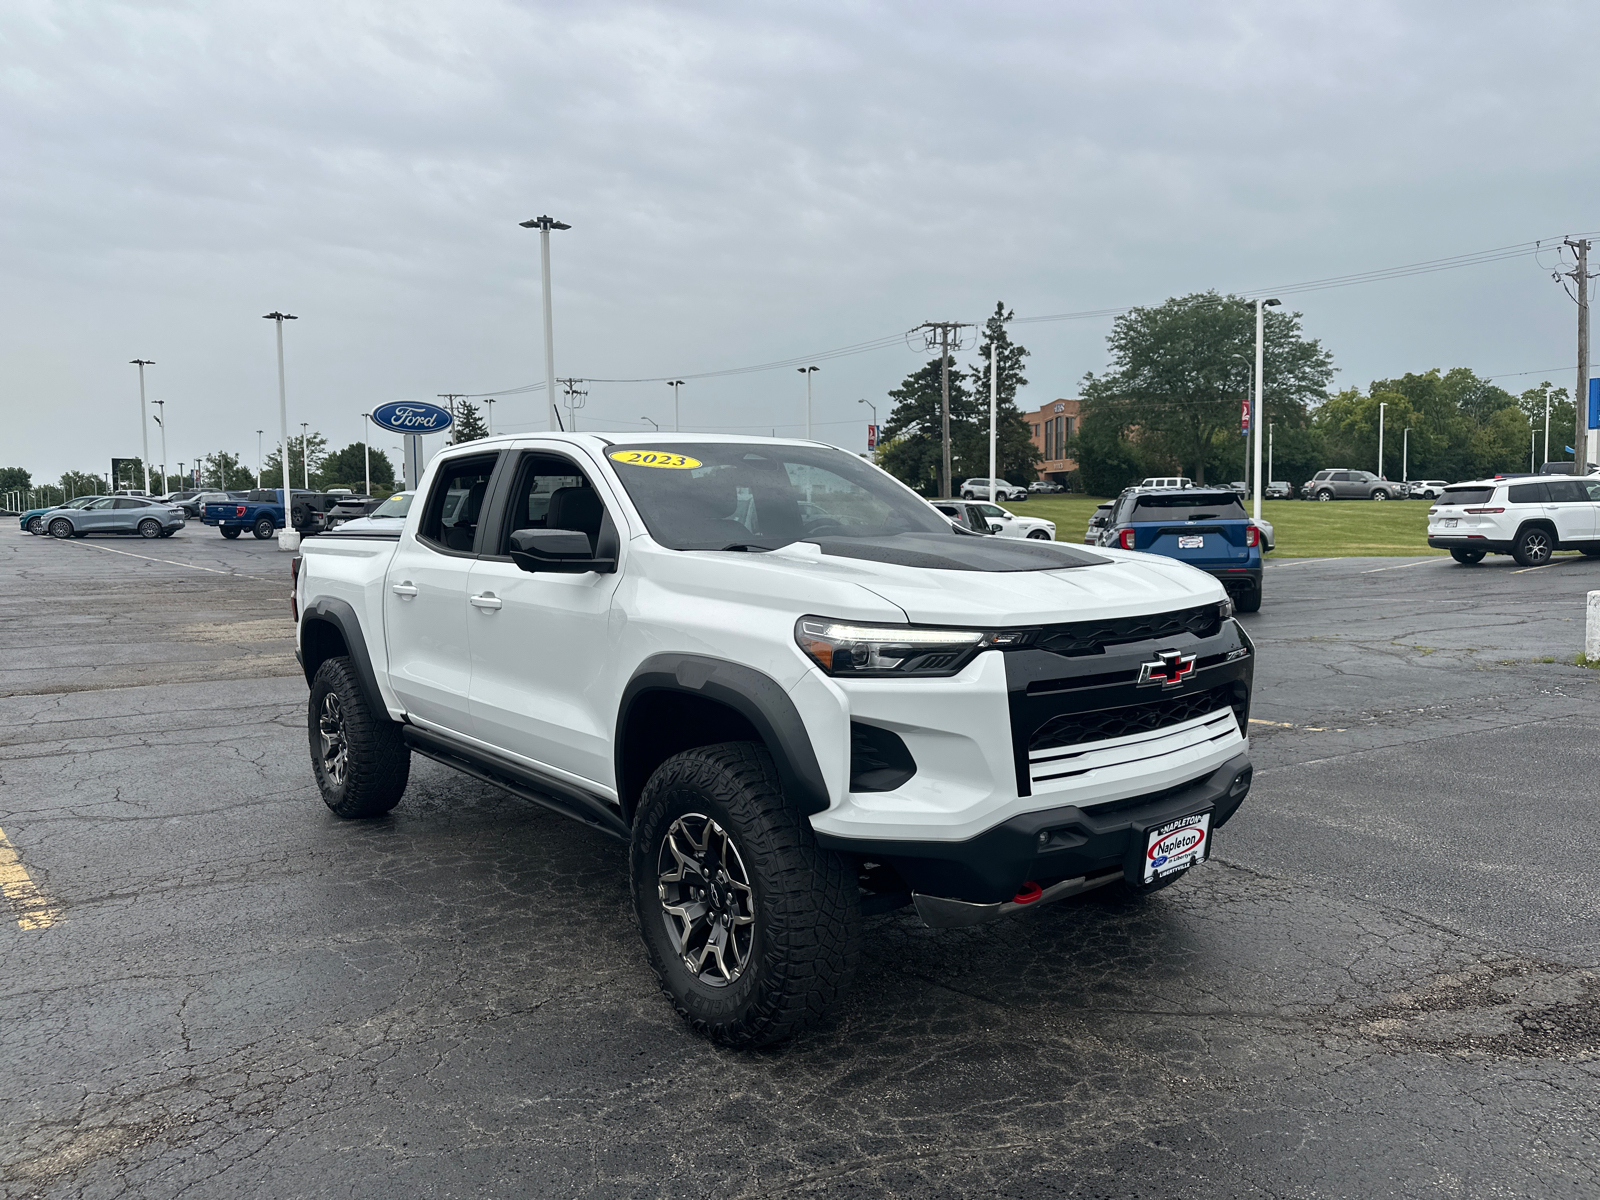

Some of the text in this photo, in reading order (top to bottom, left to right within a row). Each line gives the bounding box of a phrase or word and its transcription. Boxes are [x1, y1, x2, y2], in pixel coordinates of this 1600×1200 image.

[391, 406, 437, 427] Ford
[627, 453, 686, 466] 2023
[1163, 815, 1200, 833] NAPLETON
[1157, 835, 1196, 856] Napleton
[1173, 850, 1198, 861] Libertyville
[1159, 862, 1191, 878] LIBERTYVILLE
